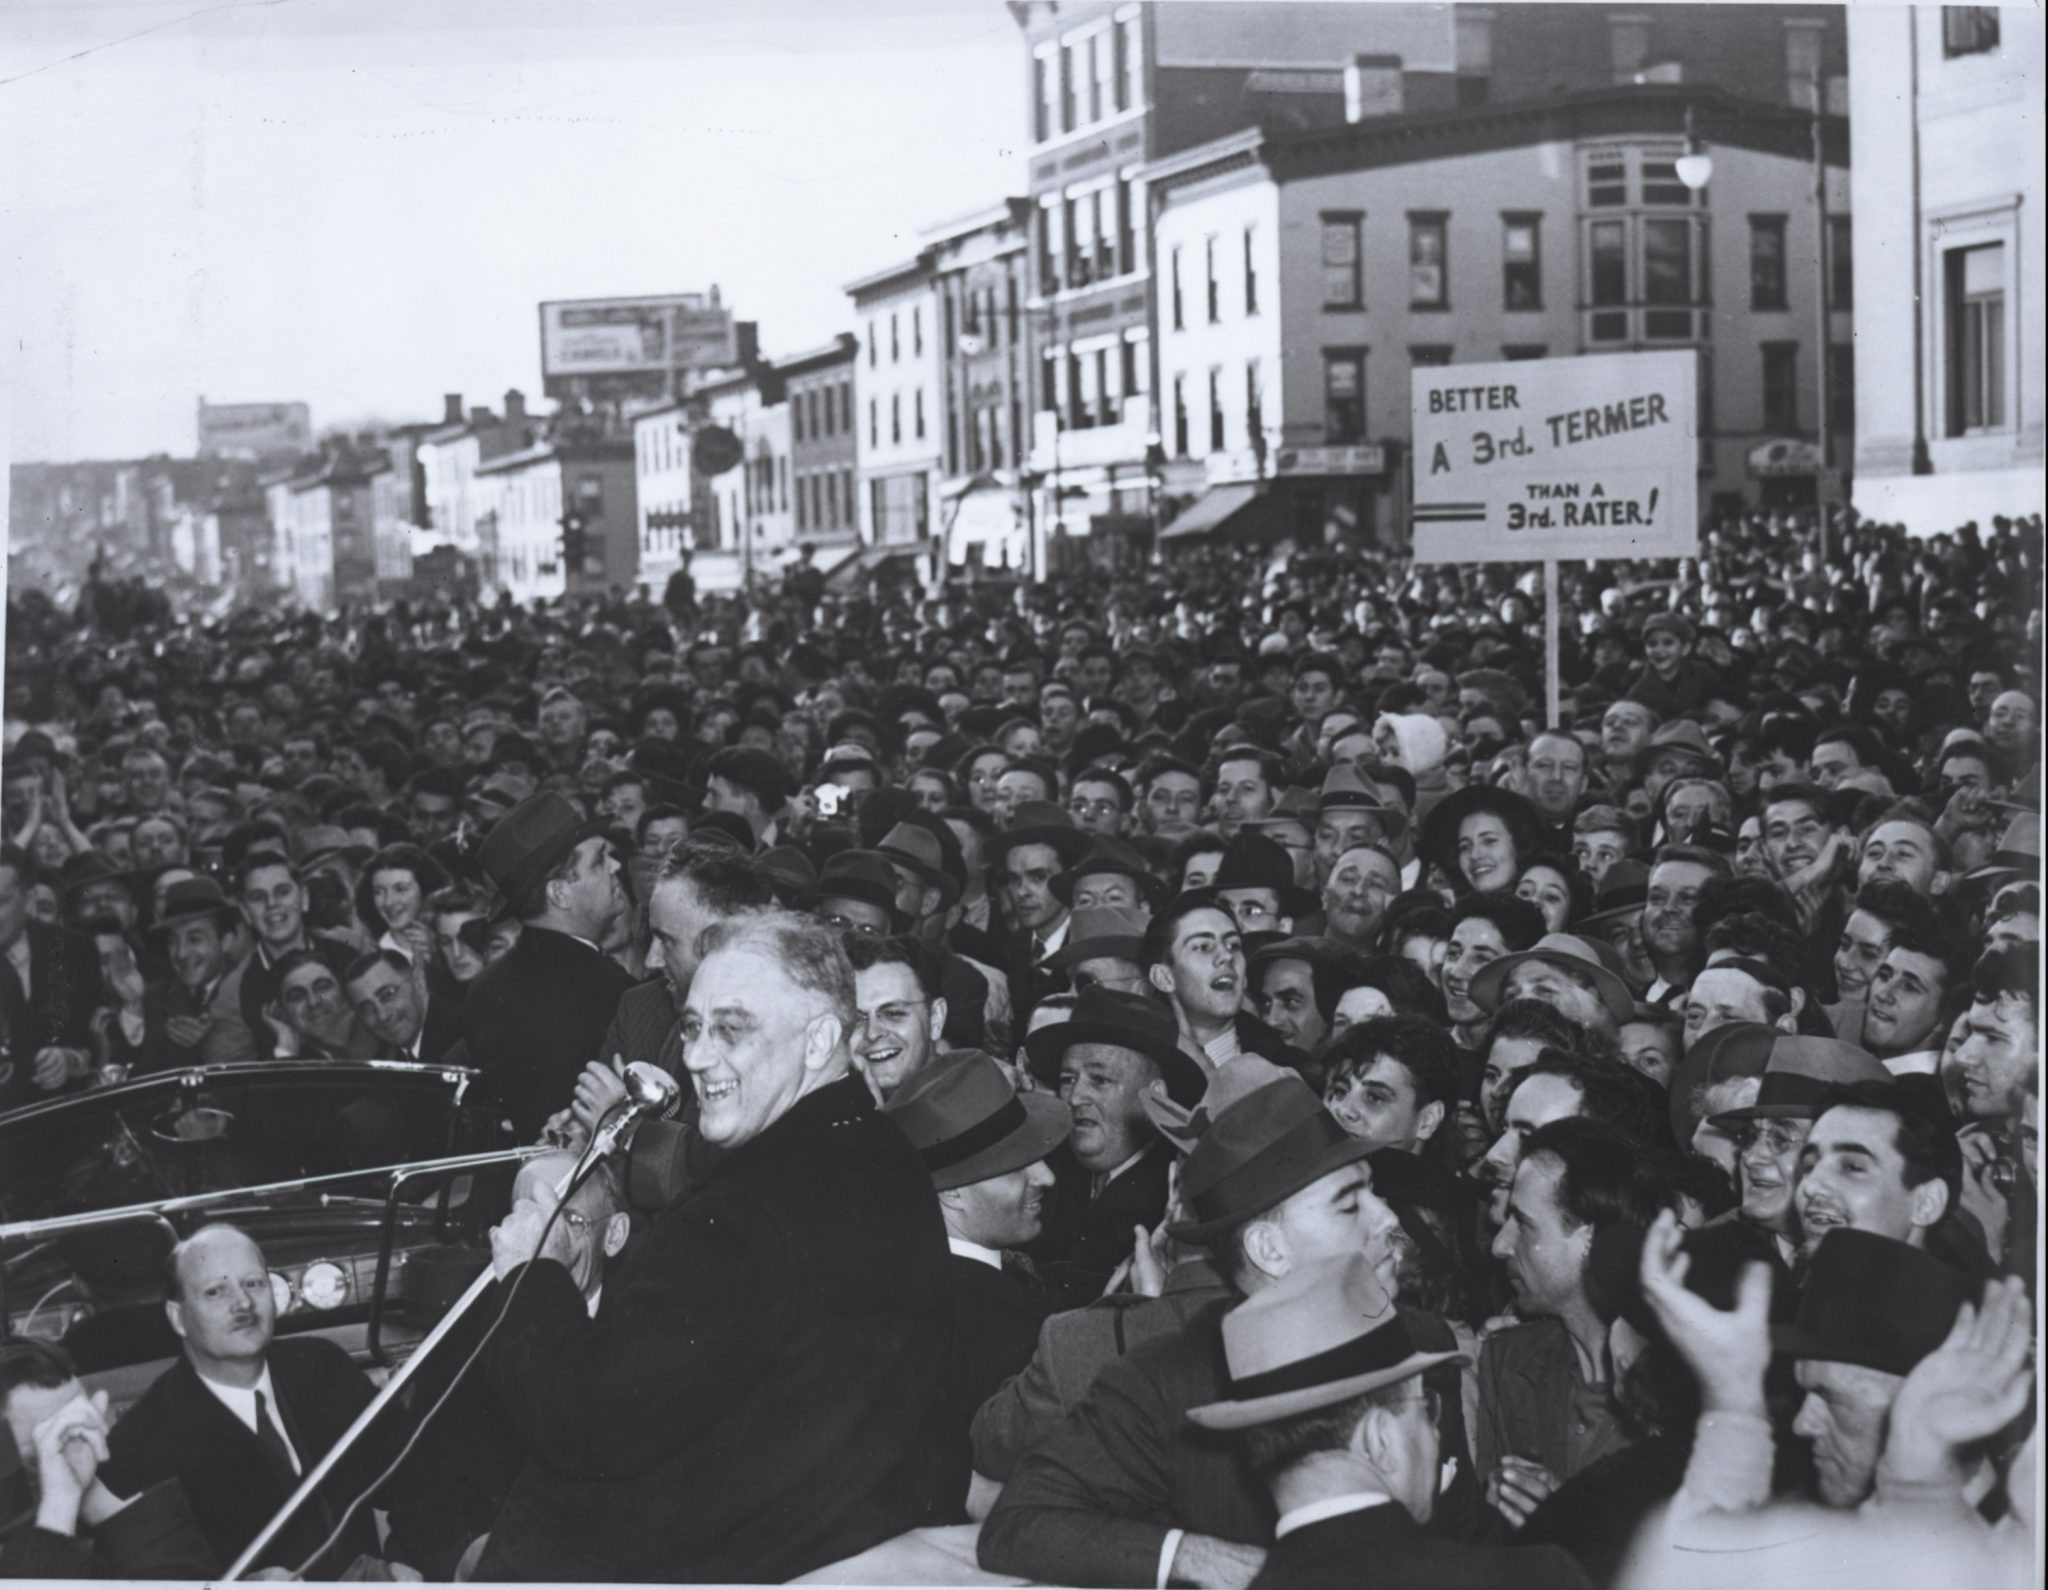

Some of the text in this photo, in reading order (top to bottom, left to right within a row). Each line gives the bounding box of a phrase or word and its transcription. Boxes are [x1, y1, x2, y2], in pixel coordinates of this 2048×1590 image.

[1428, 386, 1521, 414] BETTER
[1431, 442, 1451, 475] A
[1472, 426, 1534, 465] 3rd.
[1546, 393, 1670, 447] TERMER
[1507, 487, 1660, 531] 3rd. RATER!
[1526, 483, 1605, 499] THAN A
